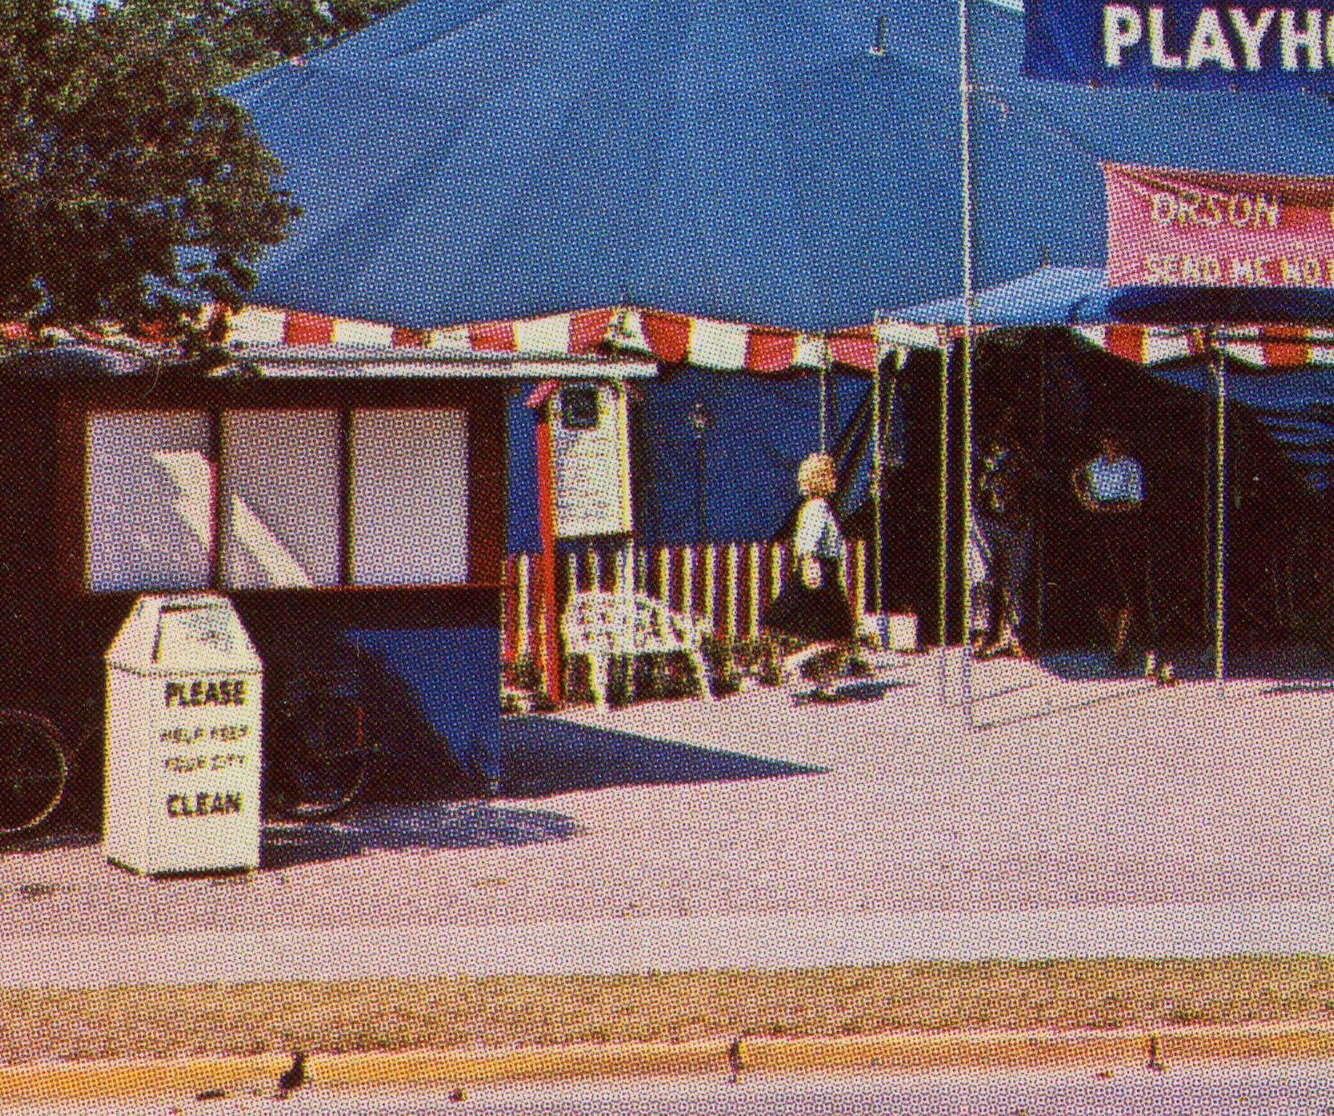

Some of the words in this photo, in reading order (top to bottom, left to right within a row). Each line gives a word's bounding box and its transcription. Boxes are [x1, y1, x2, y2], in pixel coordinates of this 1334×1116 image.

[1150, 192, 1281, 229] ORSON
[1145, 253, 1220, 284] SEND
[1231, 255, 1272, 285] ME
[1282, 255, 1321, 285] NO
[165, 680, 246, 707] PLEASE
[160, 726, 204, 744] HELP
[164, 755, 207, 773] YOUR
[211, 753, 247, 772] CITY
[167, 791, 243, 818] CLEAN
